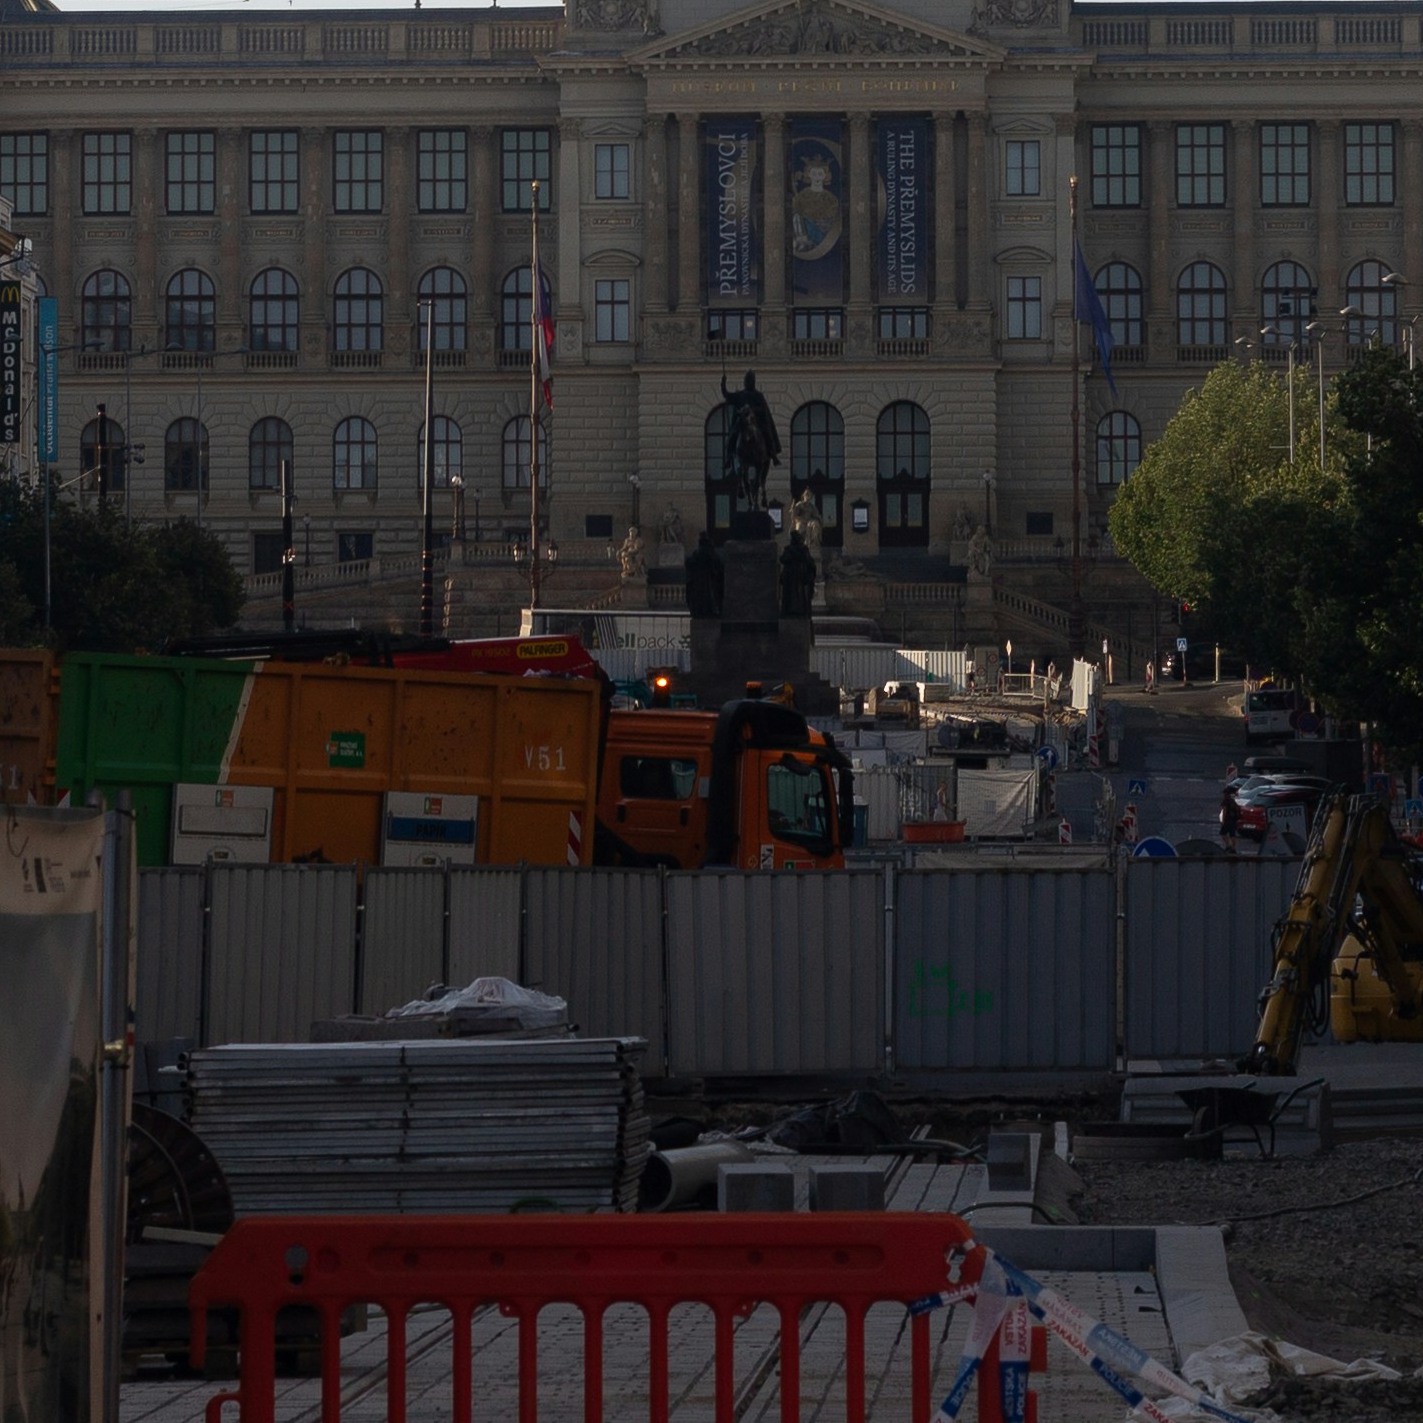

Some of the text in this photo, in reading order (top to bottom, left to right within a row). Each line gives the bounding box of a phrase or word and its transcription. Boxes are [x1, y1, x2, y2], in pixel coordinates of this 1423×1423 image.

[886, 141, 896, 178] RULING
[715, 133, 738, 296] PŘEMYSLOVCI
[887, 181, 896, 229] DYNASTY
[899, 130, 918, 293] THE PŘEMYSLIDS
[887, 230, 896, 254] AND
[887, 272, 896, 294] AGE
[2, 311, 18, 441] McDonald's
[519, 643, 566, 656] PALFINGER
[1269, 808, 1302, 818] POZOR
